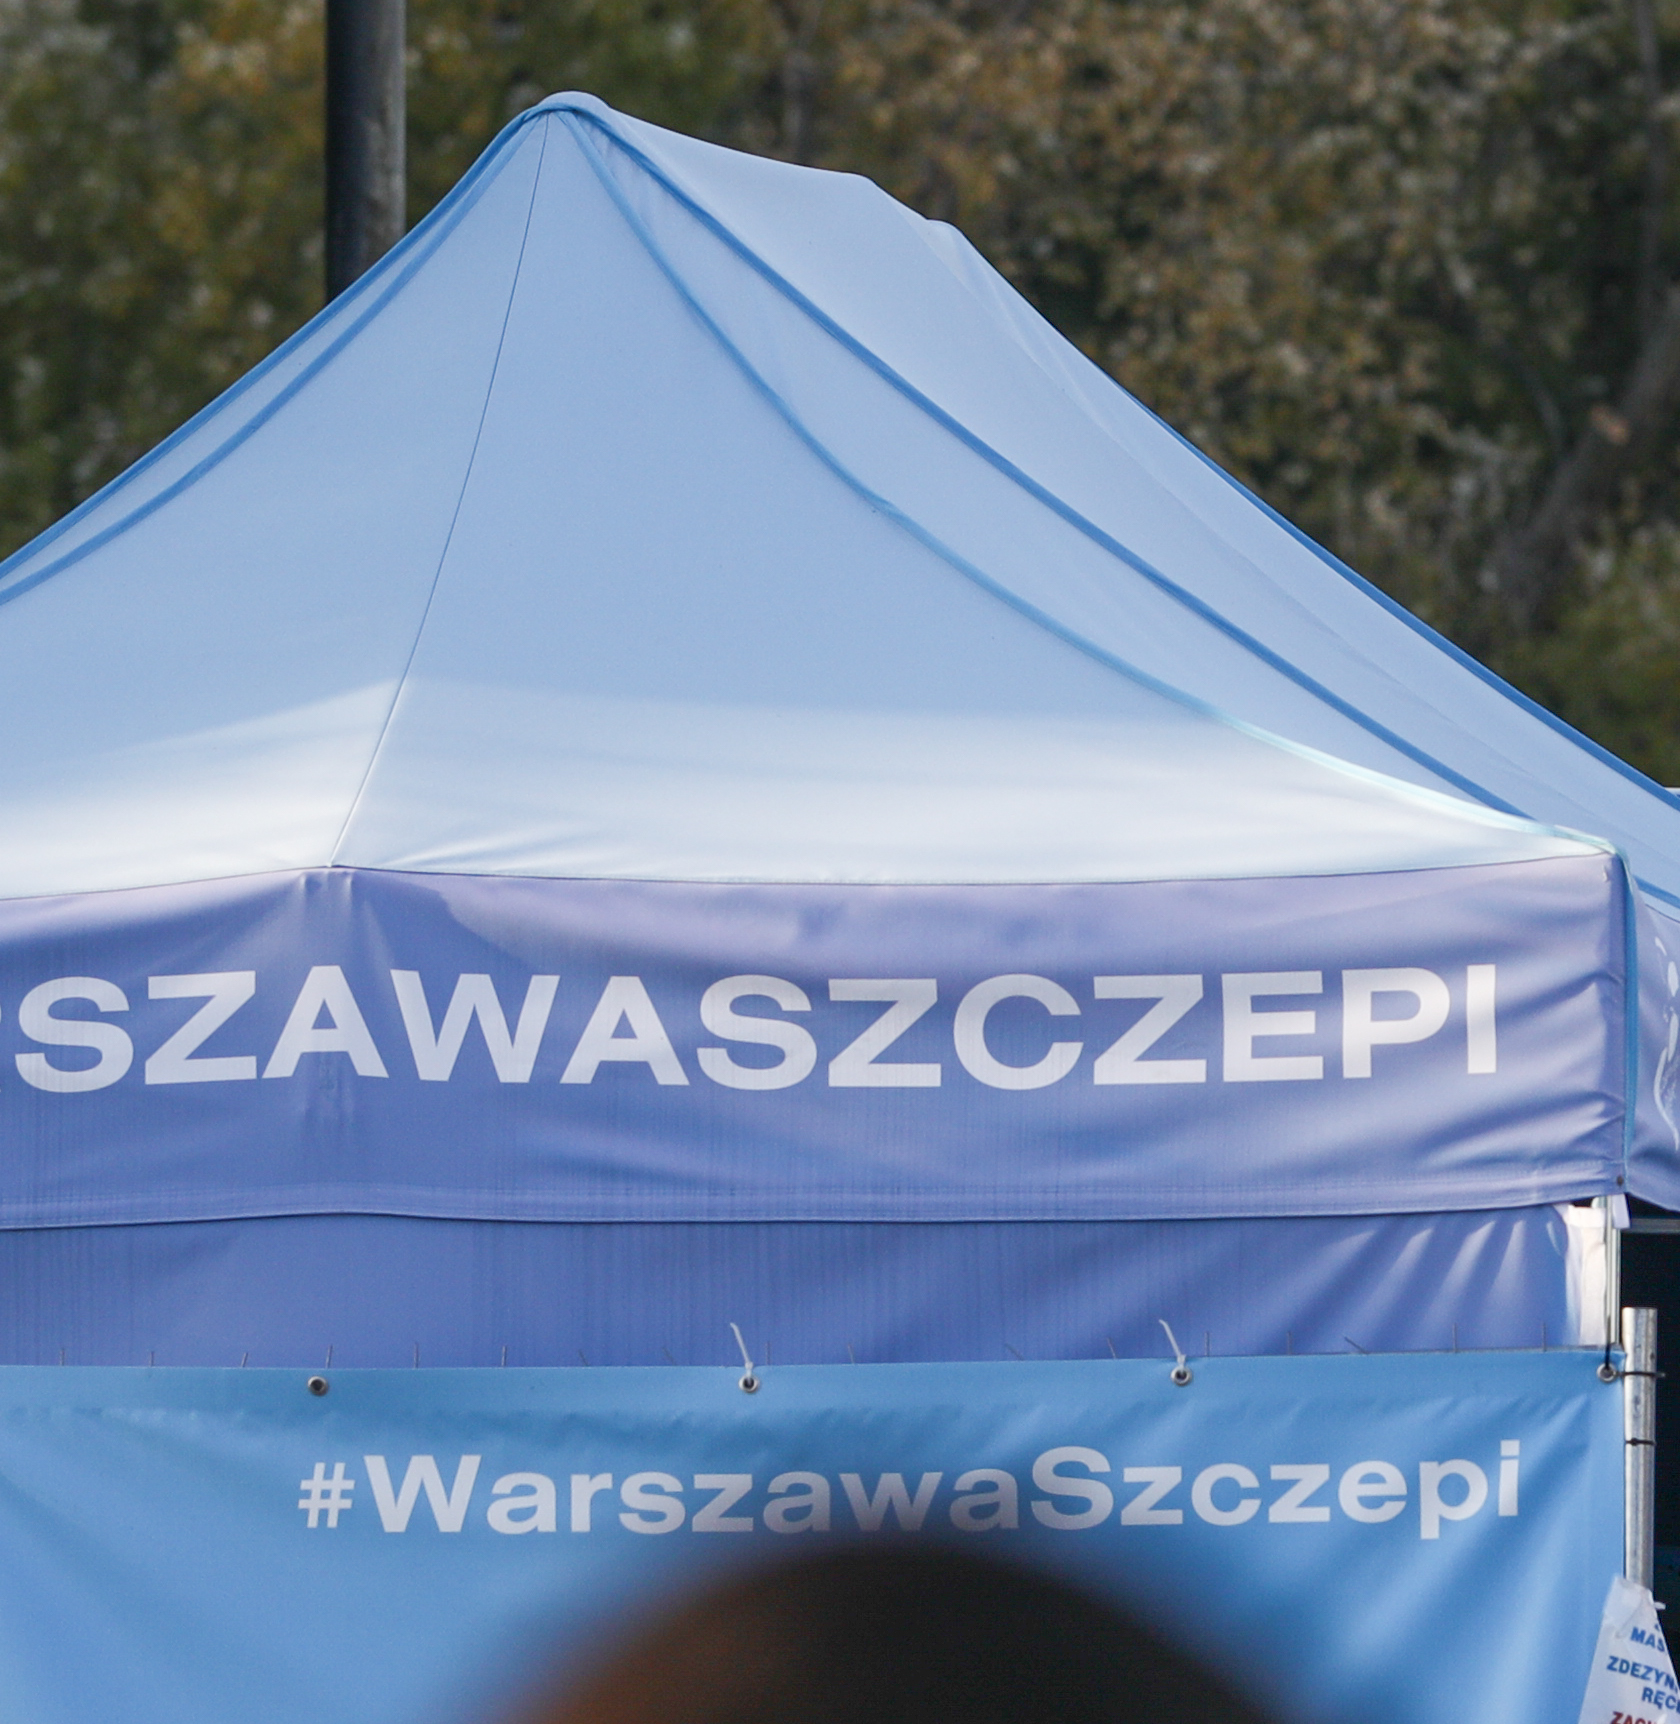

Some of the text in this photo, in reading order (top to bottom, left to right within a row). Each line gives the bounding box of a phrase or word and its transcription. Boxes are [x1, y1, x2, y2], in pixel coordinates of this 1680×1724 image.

[299, 1440, 1521, 1540] #WarszawaSzczepi
[1630, 1626, 1666, 1653] MAS
[1606, 1655, 1679, 1695] ZDEZYN
